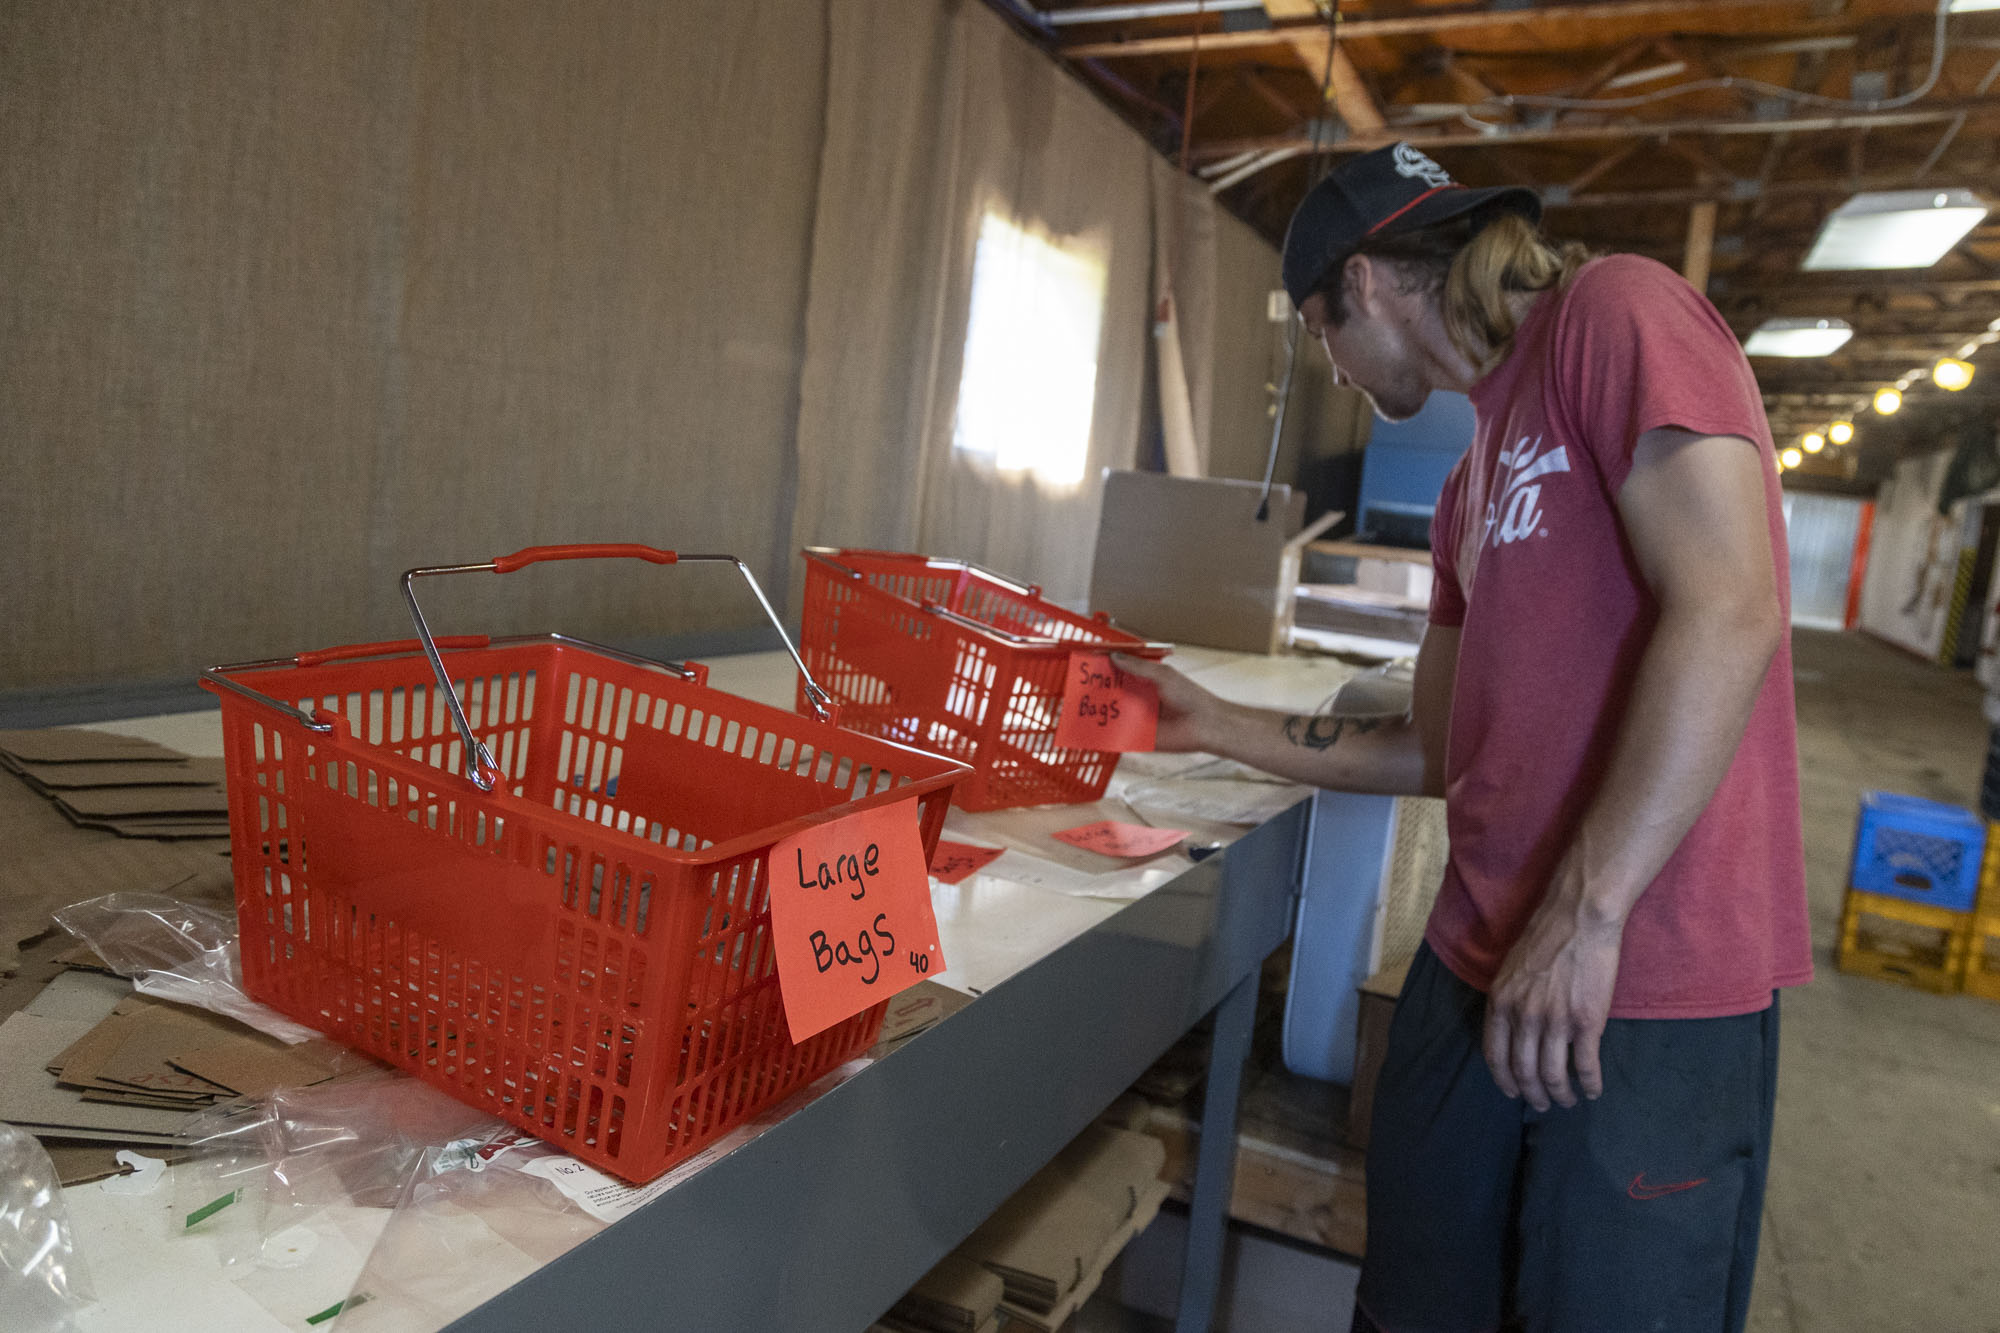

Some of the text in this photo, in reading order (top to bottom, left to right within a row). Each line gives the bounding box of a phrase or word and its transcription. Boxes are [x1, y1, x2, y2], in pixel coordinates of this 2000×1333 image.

[1080, 661, 1124, 689] Small
[1078, 694, 1121, 727] Bags
[797, 843, 880, 901] Large
[808, 913, 896, 985] Bags
[909, 951, 929, 974] 40
